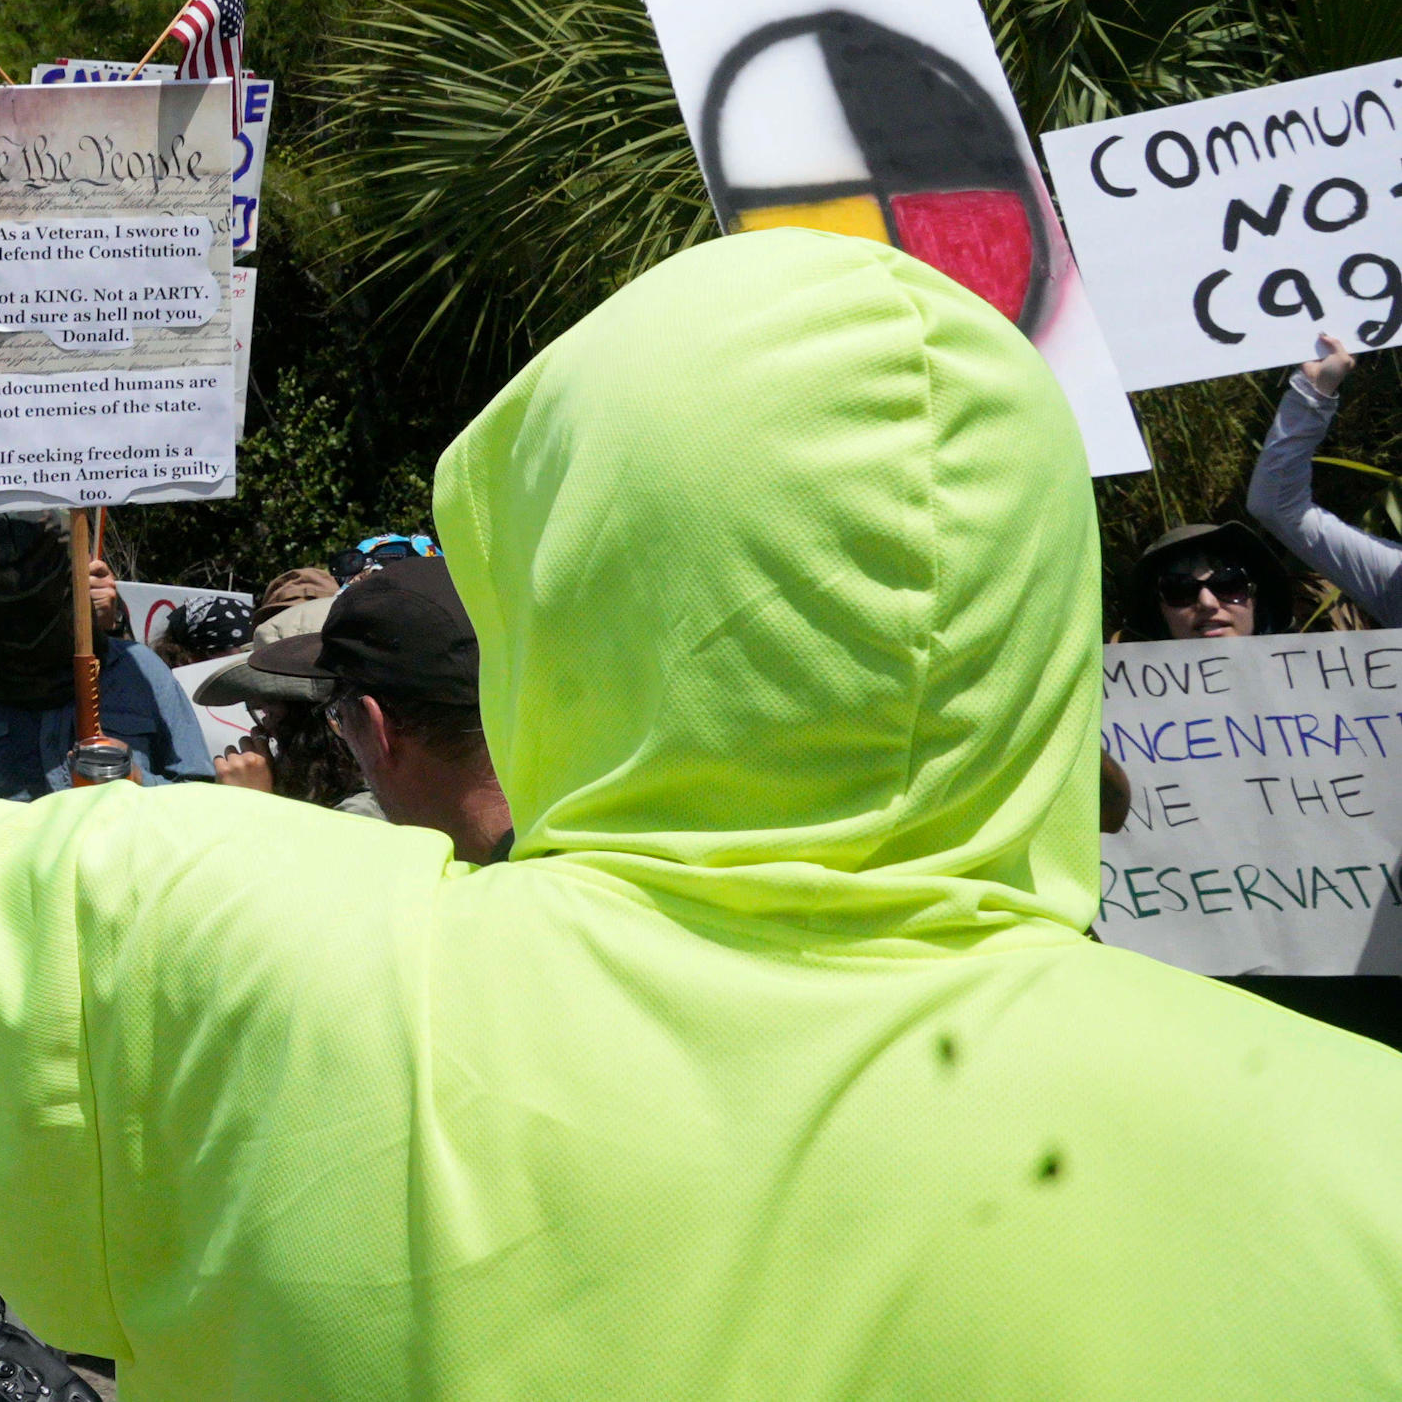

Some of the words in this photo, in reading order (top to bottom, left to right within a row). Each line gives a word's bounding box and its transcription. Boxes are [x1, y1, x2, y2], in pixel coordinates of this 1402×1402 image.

[1090, 79, 1402, 198] Commun
[75, 133, 203, 195] People
[22, 231, 31, 240] a
[36, 226, 109, 242] Veteran,
[114, 225, 122, 238] I
[126, 228, 178, 239] swore
[183, 225, 200, 238] to
[57, 245, 84, 260] the
[89, 243, 202, 260] Constitution.
[20, 293, 30, 304] a
[34, 288, 89, 304] KING.
[94, 287, 124, 302] Not
[129, 290, 138, 301] a
[143, 285, 209, 301] PARTY.
[30, 312, 68, 323] sure
[73, 311, 91, 322] as
[96, 307, 127, 321] hell
[132, 308, 161, 321] not
[166, 308, 202, 324] you,
[62, 328, 130, 344] Donald.
[114, 376, 183, 391] humans
[188, 377, 217, 389] are
[25, 402, 96, 417] enemies
[101, 399, 119, 414] of
[123, 399, 151, 413] the
[155, 399, 201, 413] state.
[0, 450, 15, 465] If
[18, 448, 83, 466] seeking
[87, 445, 160, 462] freedom
[165, 444, 179, 458] is
[183, 446, 193, 458] a
[32, 468, 71, 483] then
[75, 465, 148, 482] America
[153, 463, 167, 477] is
[172, 460, 221, 480] guilty
[79, 486, 112, 501] too.
[1271, 645, 1402, 691] THE
[1243, 774, 1375, 818] THE
